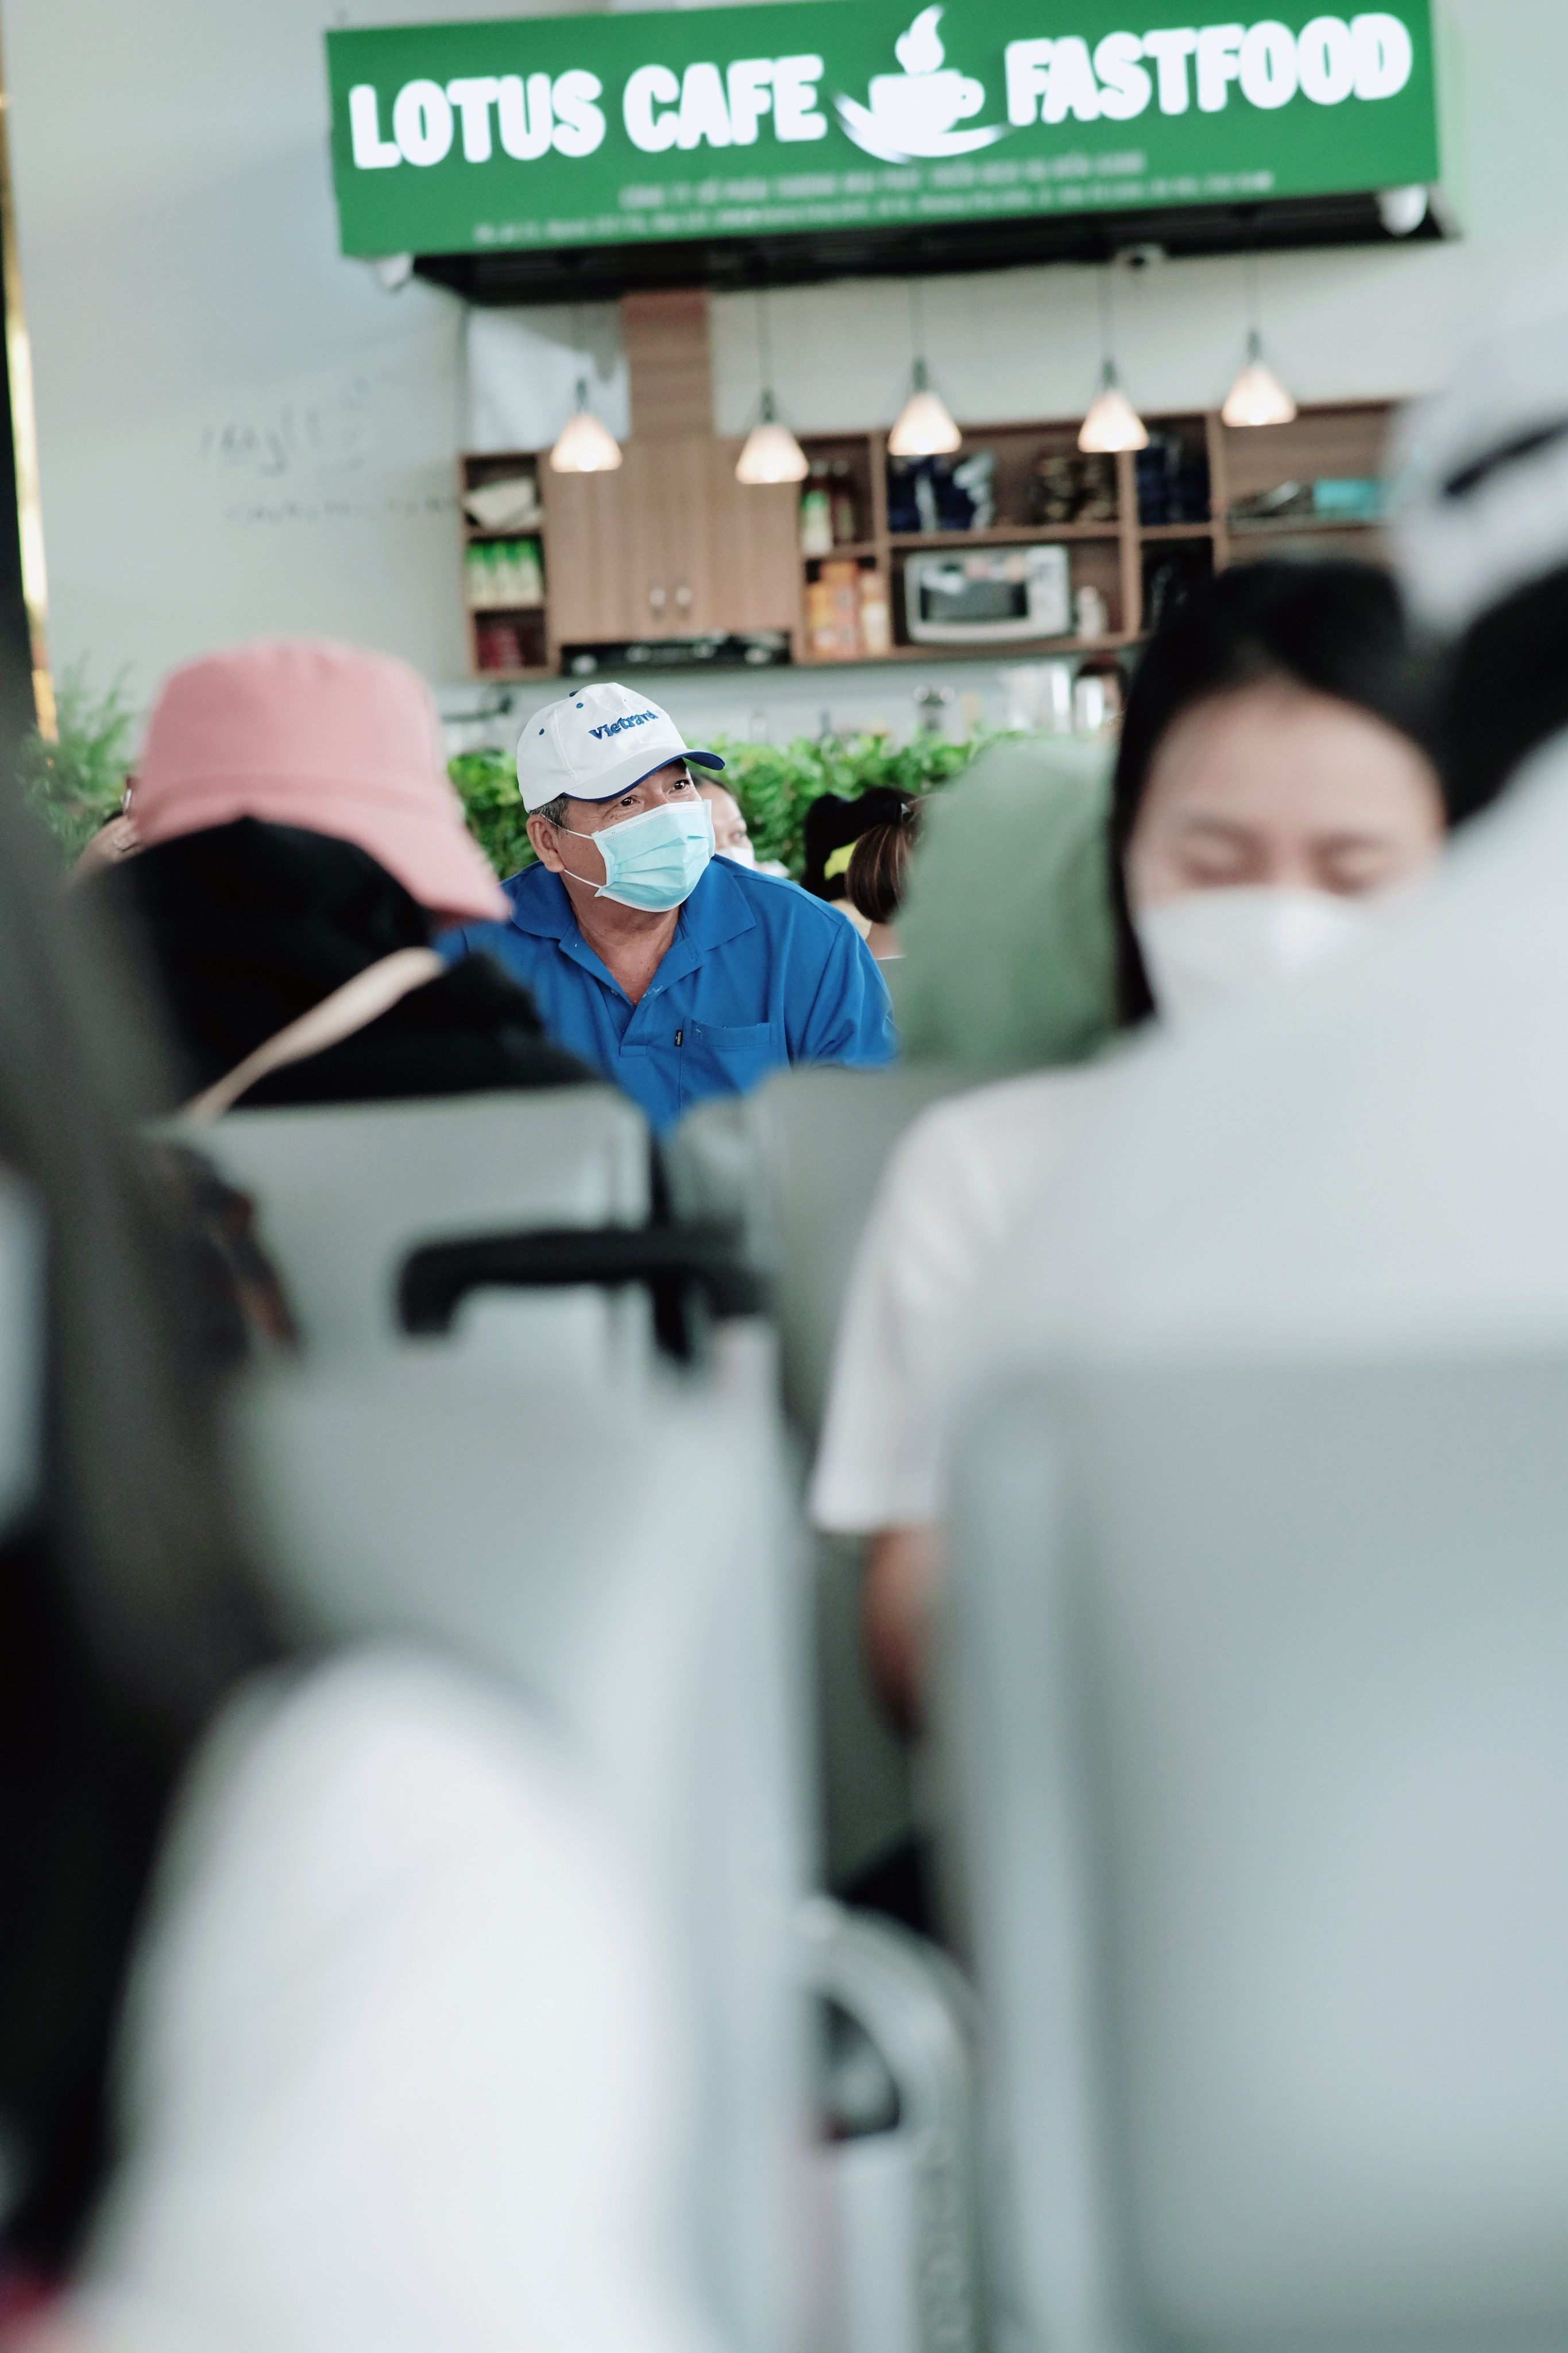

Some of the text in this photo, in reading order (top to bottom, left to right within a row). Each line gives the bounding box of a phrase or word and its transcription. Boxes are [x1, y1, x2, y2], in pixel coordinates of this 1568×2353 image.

[349, 13, 1412, 170] LOTUS CAFE FASTFOOD
